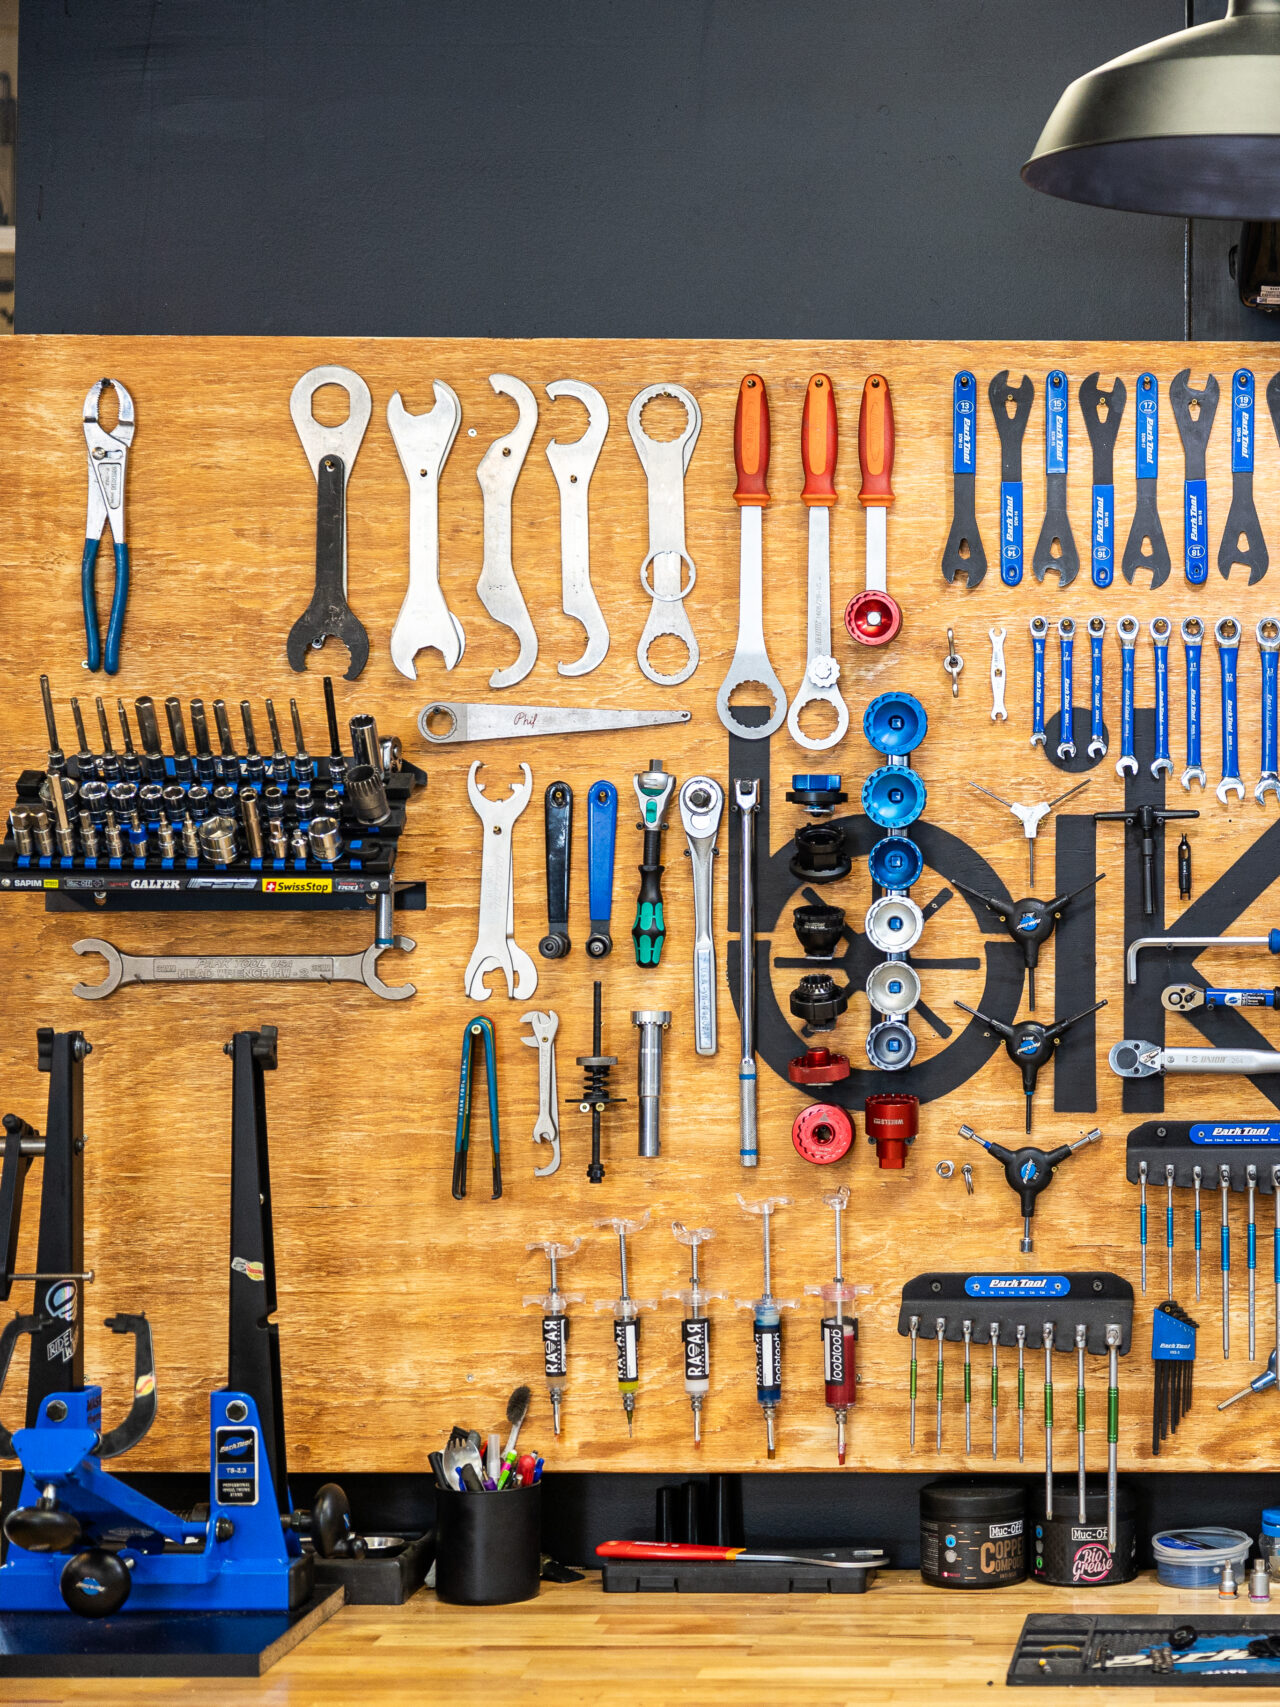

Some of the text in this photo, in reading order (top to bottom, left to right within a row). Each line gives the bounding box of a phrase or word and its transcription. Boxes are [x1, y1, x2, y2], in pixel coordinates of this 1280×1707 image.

[513, 711, 539, 731] Phil
[14, 879, 42, 887] SAPIM
[131, 878, 180, 890] GALFER
[277, 881, 330, 893] SwissStop
[194, 959, 294, 968] PARK TOOL USA
[177, 968, 270, 979] HEAD WRENCH
[830, 1329, 842, 1382] loobtoob
[990, 1521, 1023, 1538] Muc-Off
[1074, 1530, 1108, 1540] Muc-Of
[1082, 1548, 1102, 1564] Bio
[1072, 1557, 1114, 1582] Grease
